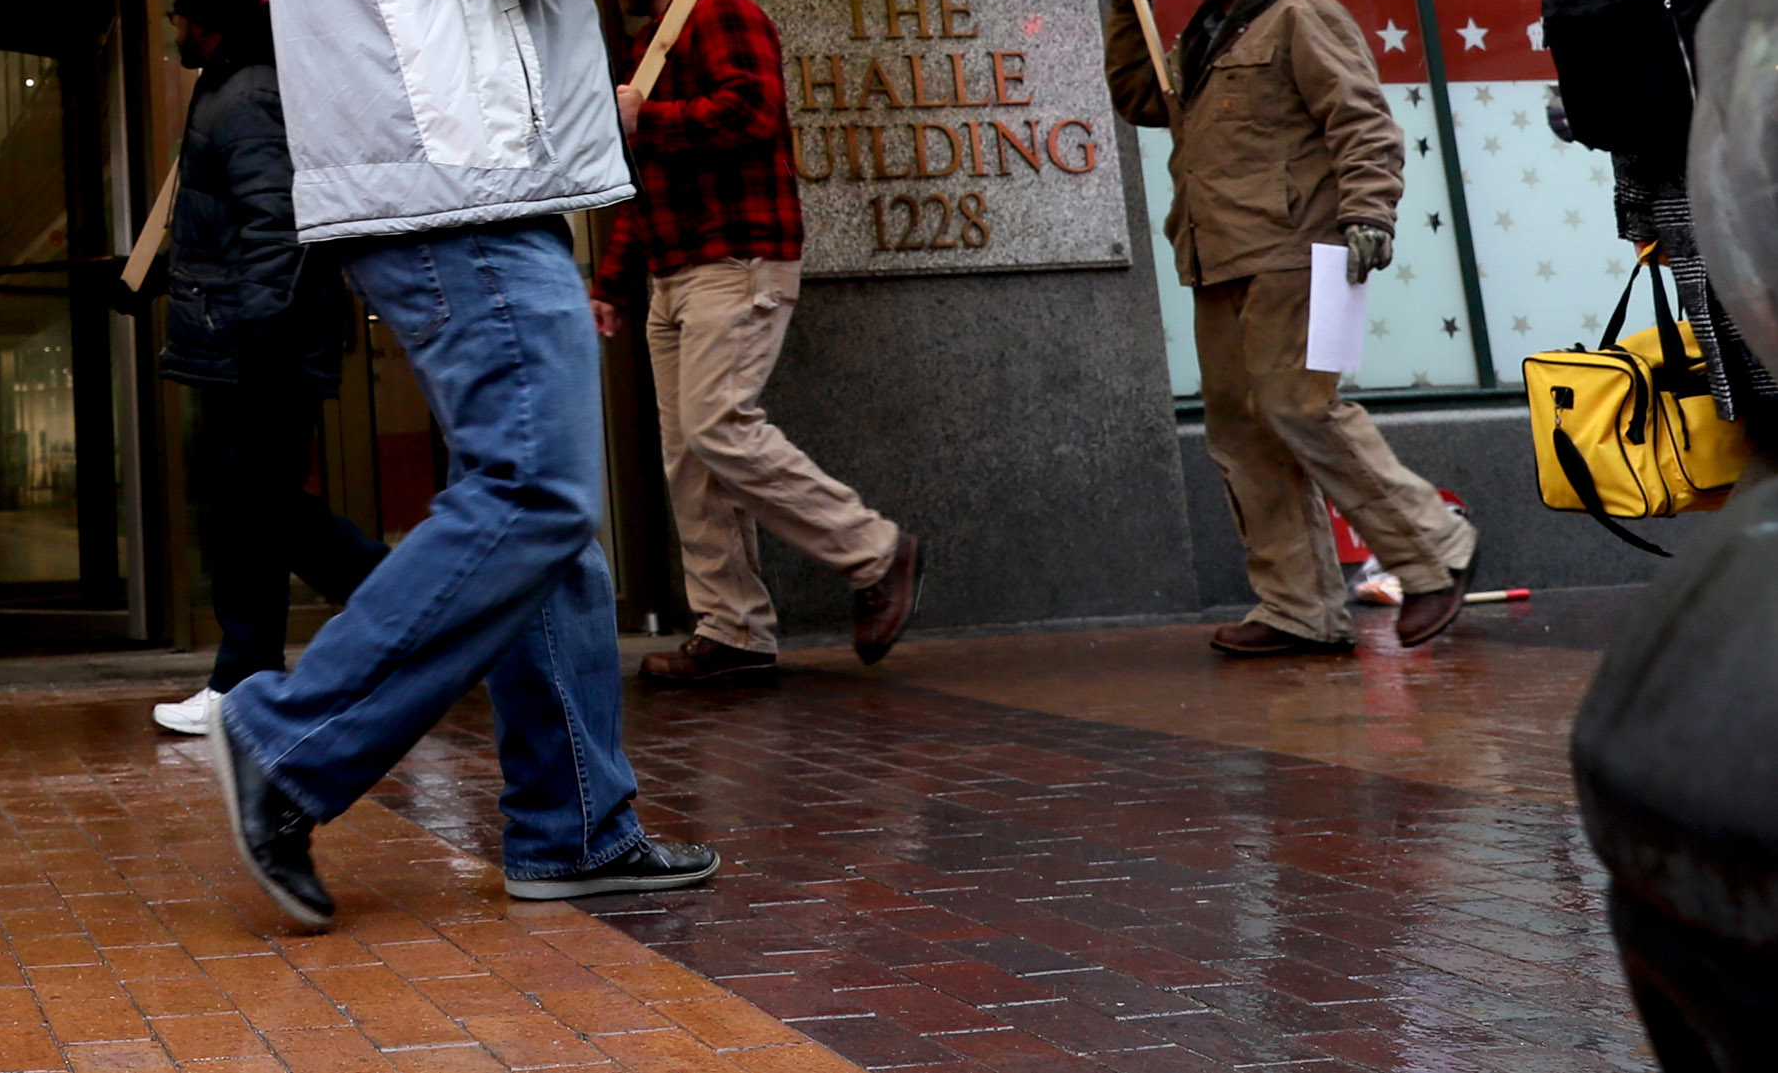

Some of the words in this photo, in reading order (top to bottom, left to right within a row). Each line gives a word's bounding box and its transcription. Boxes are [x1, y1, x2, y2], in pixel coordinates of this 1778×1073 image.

[794, 50, 1035, 111] HALLE
[792, 118, 1098, 182] UILDING
[869, 191, 992, 253] 1228
